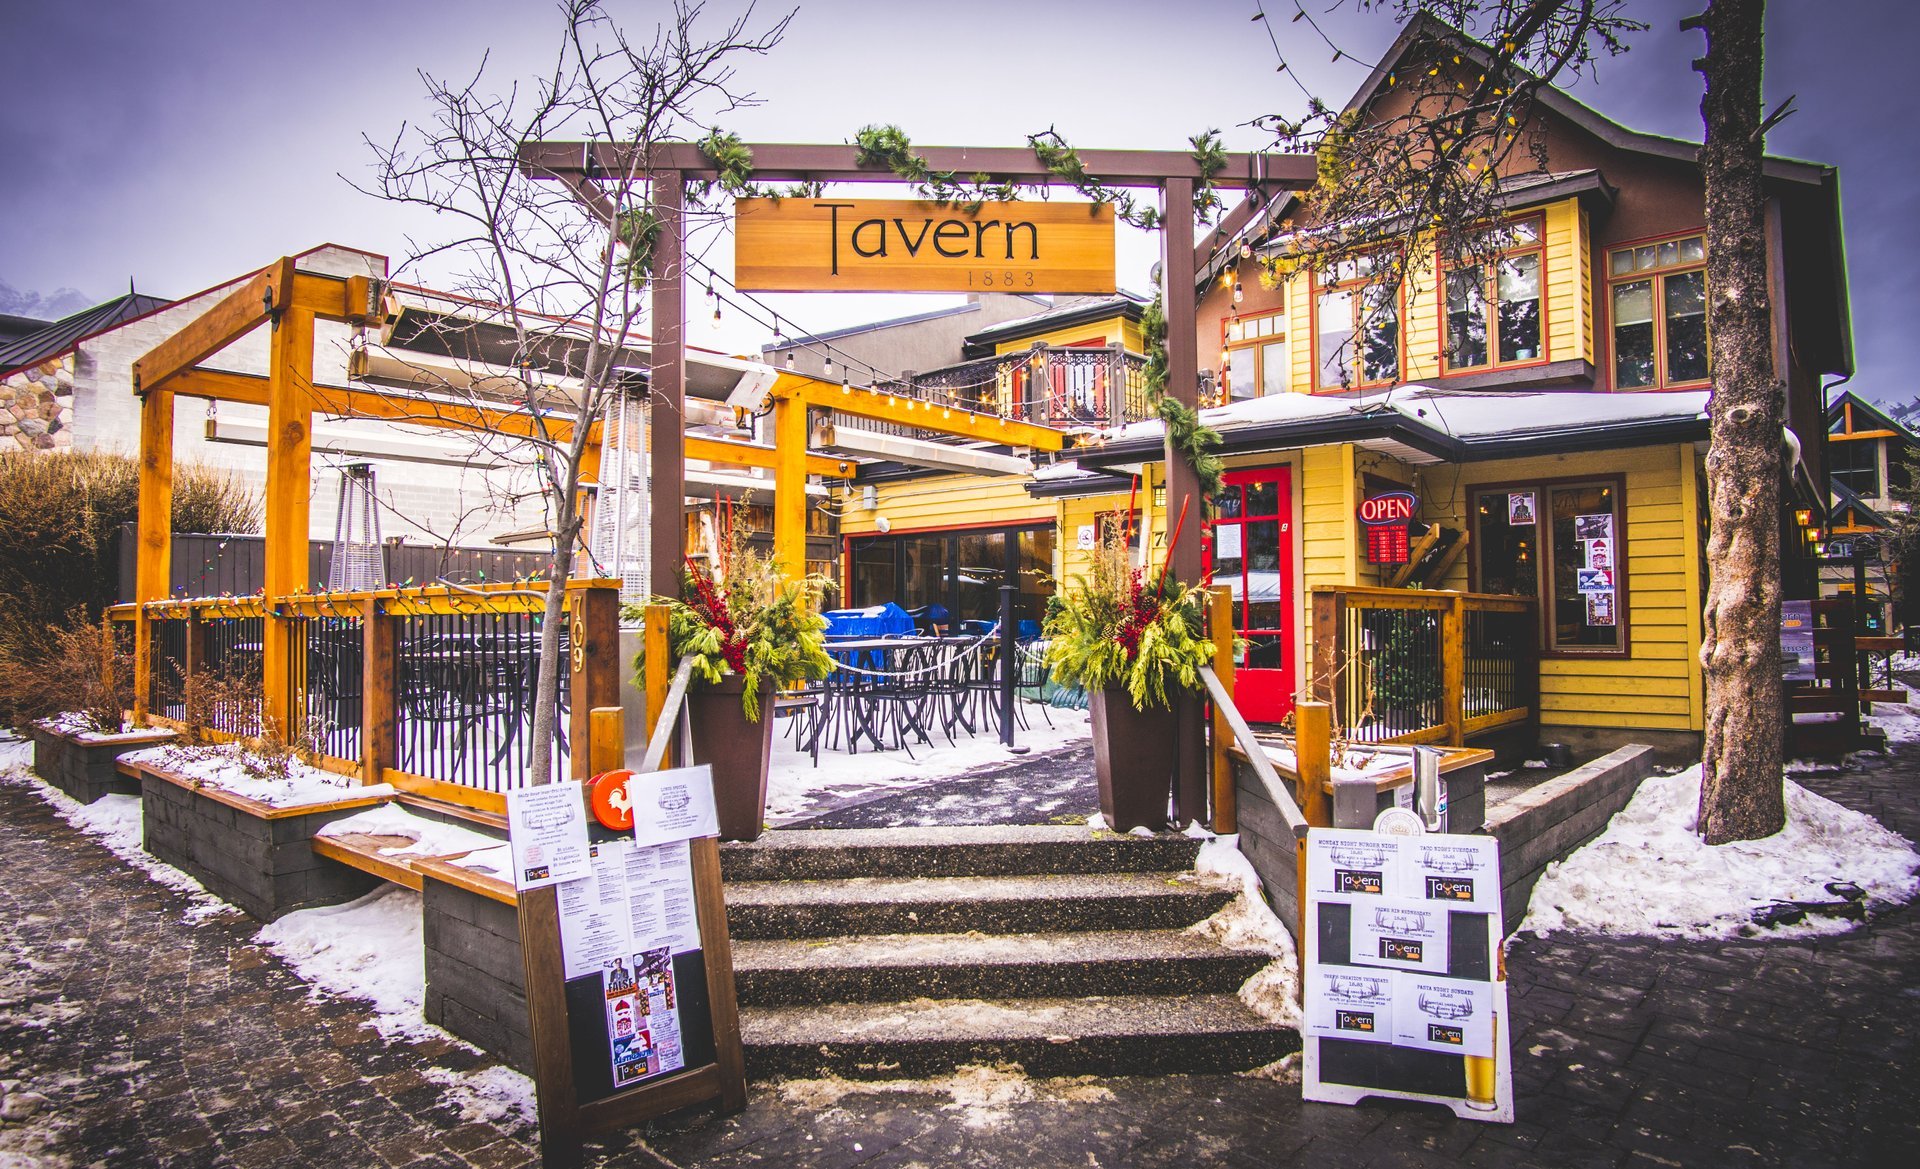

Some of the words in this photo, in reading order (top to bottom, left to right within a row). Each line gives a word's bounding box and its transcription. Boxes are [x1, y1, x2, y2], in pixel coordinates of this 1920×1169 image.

[813, 203, 1040, 276] Tavern
[968, 270, 1035, 287] 1883
[1361, 498, 1410, 520] OPEN
[573, 595, 584, 673] 709
[1337, 872, 1380, 892] Tavern
[1428, 879, 1471, 898] Tavern
[1381, 940, 1420, 958] Tavern
[608, 978, 633, 992] FALSE
[1338, 1012, 1372, 1029] Tavern
[1430, 1026, 1461, 1040] Tavern
[619, 1062, 647, 1080] Tavern
